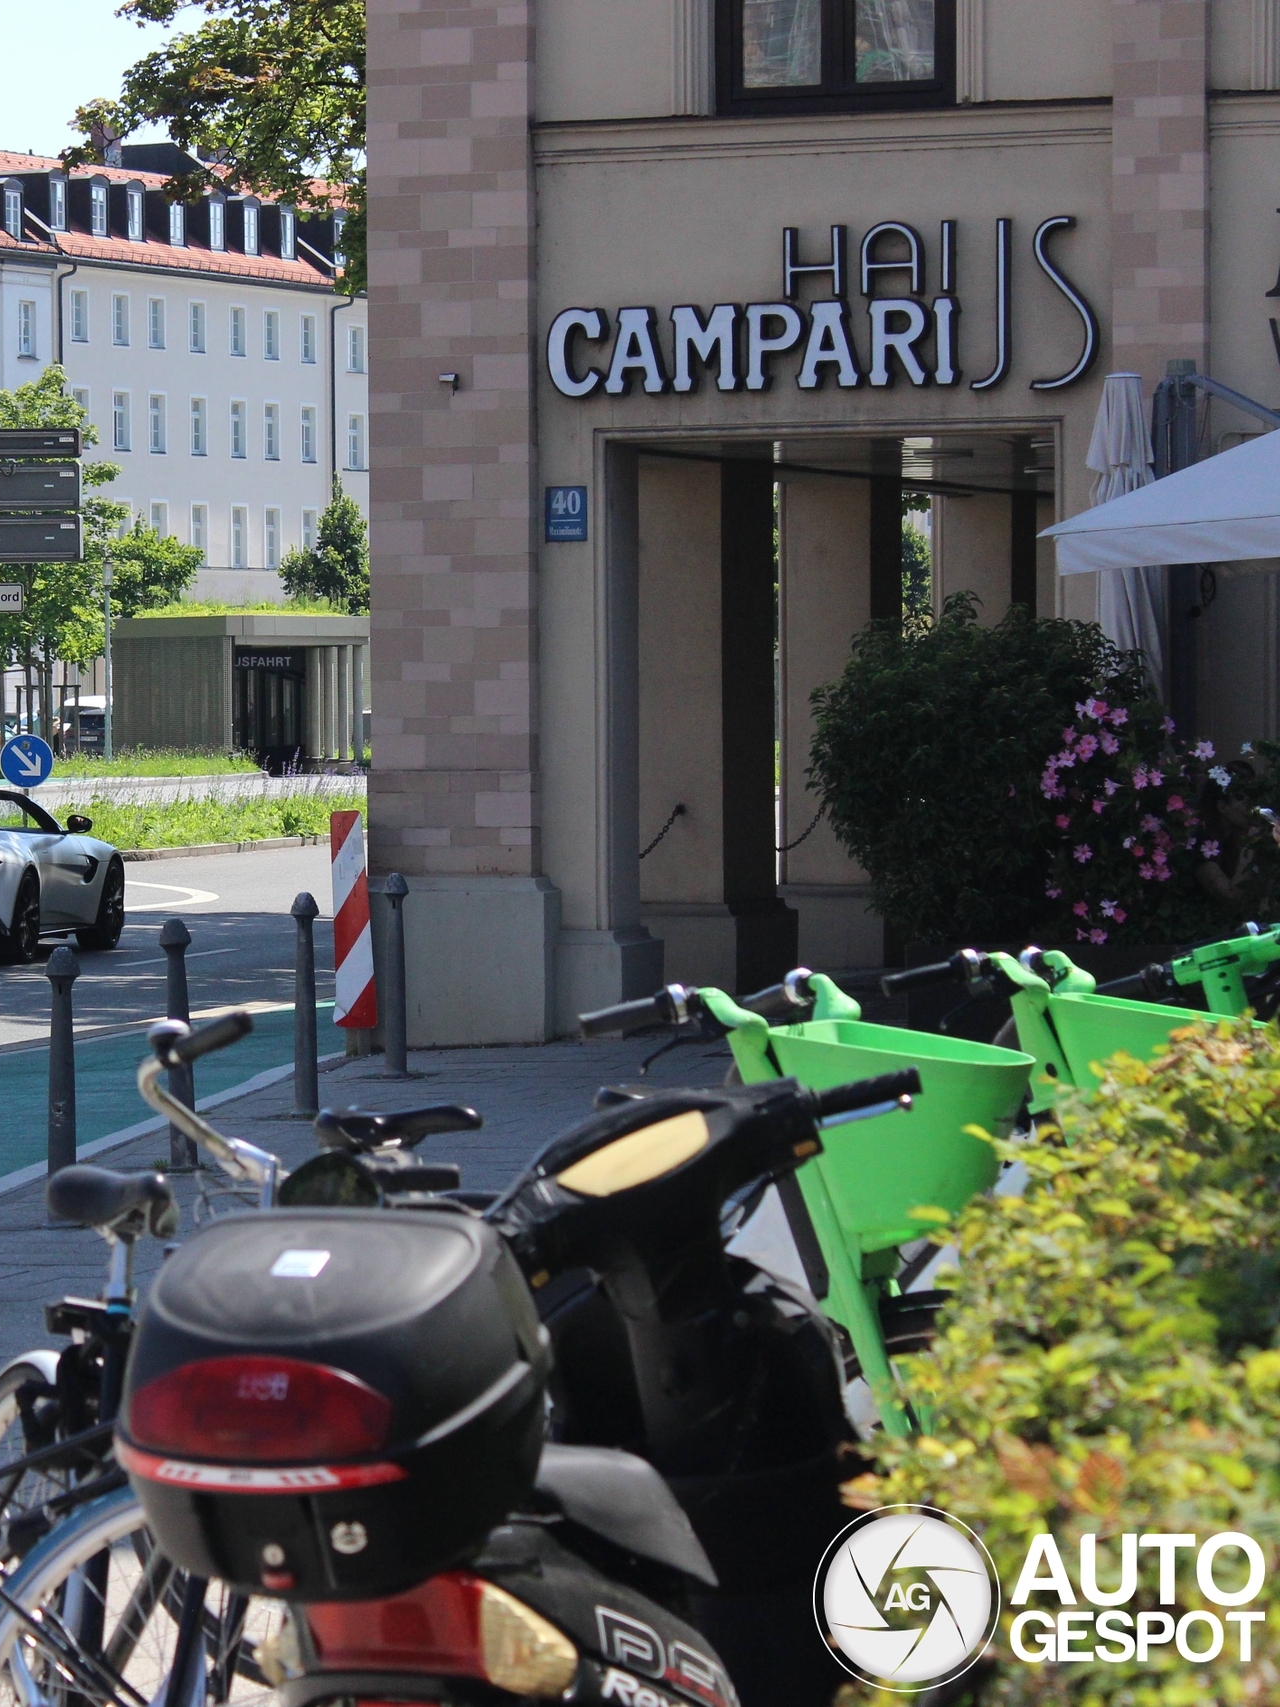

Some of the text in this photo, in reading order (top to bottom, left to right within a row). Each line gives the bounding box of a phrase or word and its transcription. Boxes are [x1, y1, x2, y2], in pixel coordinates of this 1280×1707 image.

[547, 297, 962, 399] CAMPARI
[783, 215, 1101, 390] HAUS
[552, 490, 581, 515] 40
